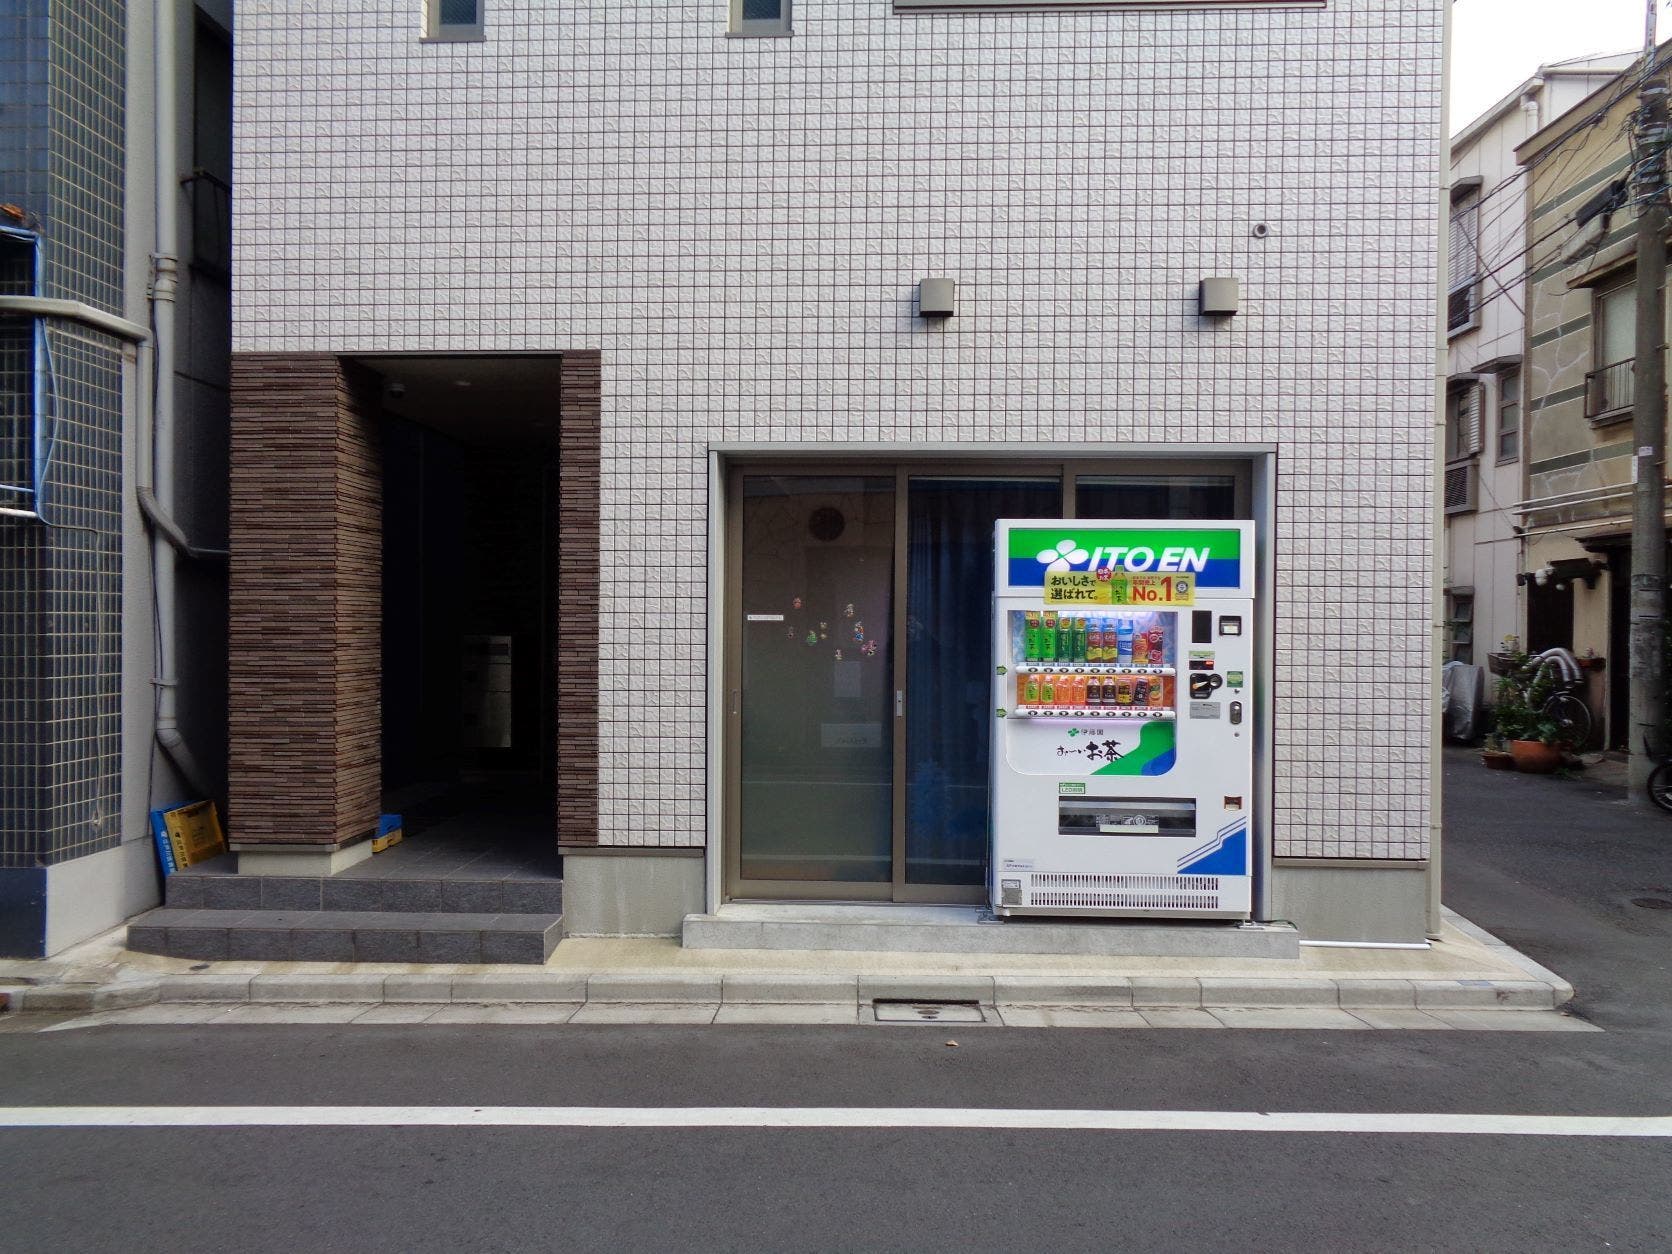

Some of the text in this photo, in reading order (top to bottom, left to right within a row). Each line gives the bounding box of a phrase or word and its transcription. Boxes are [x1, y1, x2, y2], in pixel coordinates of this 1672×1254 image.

[1089, 547, 1210, 572] ITO EN
[1051, 575, 1096, 587] おいしさで
[1132, 576, 1172, 601] No.1
